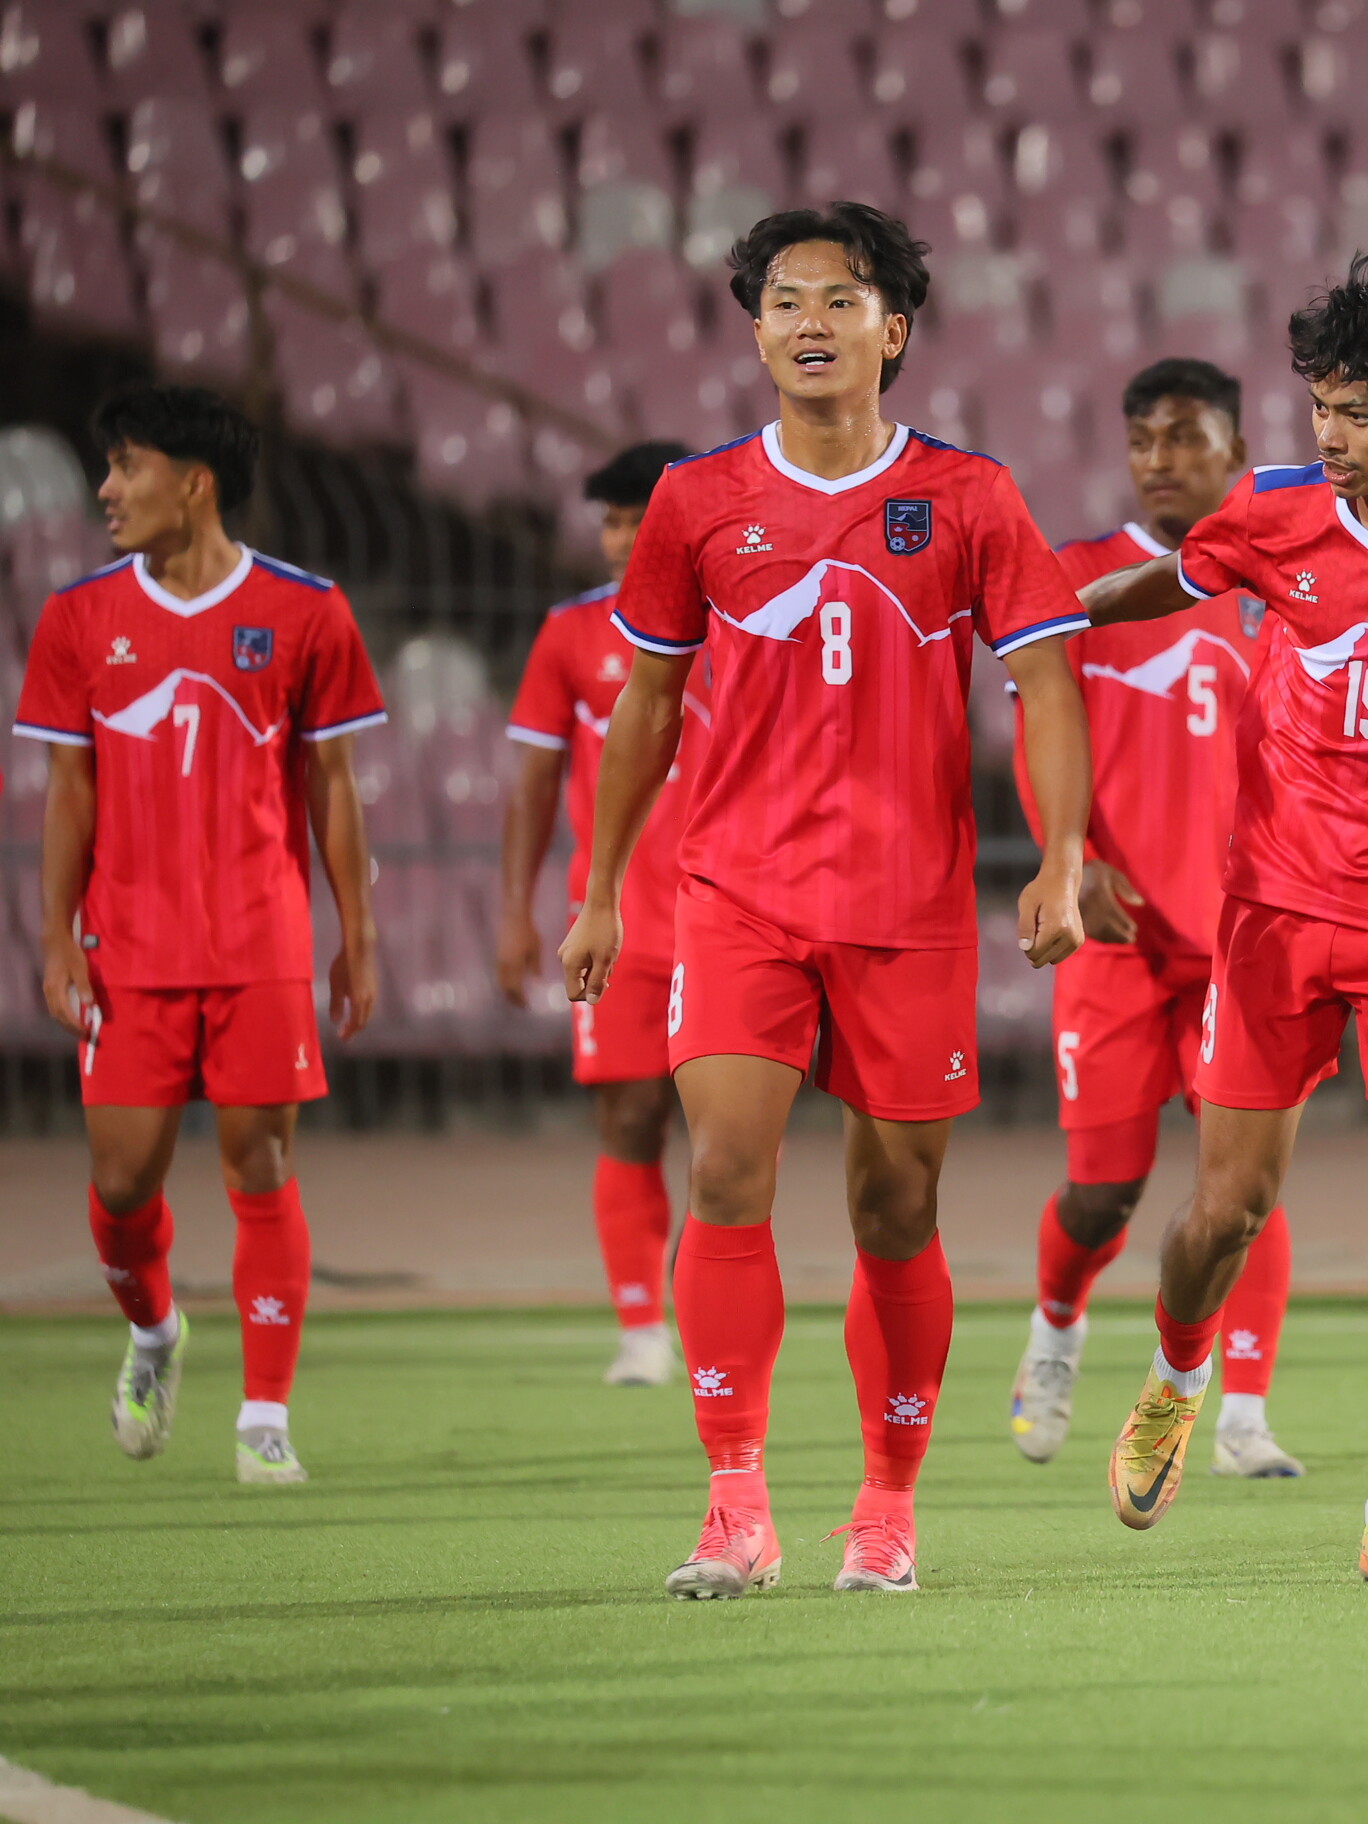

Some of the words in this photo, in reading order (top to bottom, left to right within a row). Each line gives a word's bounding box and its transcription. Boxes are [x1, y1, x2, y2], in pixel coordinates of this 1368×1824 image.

[736, 543, 773, 555] KELME
[1289, 589, 1319, 604] KELME
[819, 601, 853, 685] 8
[1186, 665, 1217, 737] 5
[173, 704, 200, 777] 7
[667, 962, 685, 1039] 8
[1201, 983, 1218, 1064] 9
[944, 1068, 967, 1081] KELME
[1058, 1031, 1080, 1101] 5
[694, 1387, 733, 1397] KELME
[884, 1412, 928, 1426] KELME
